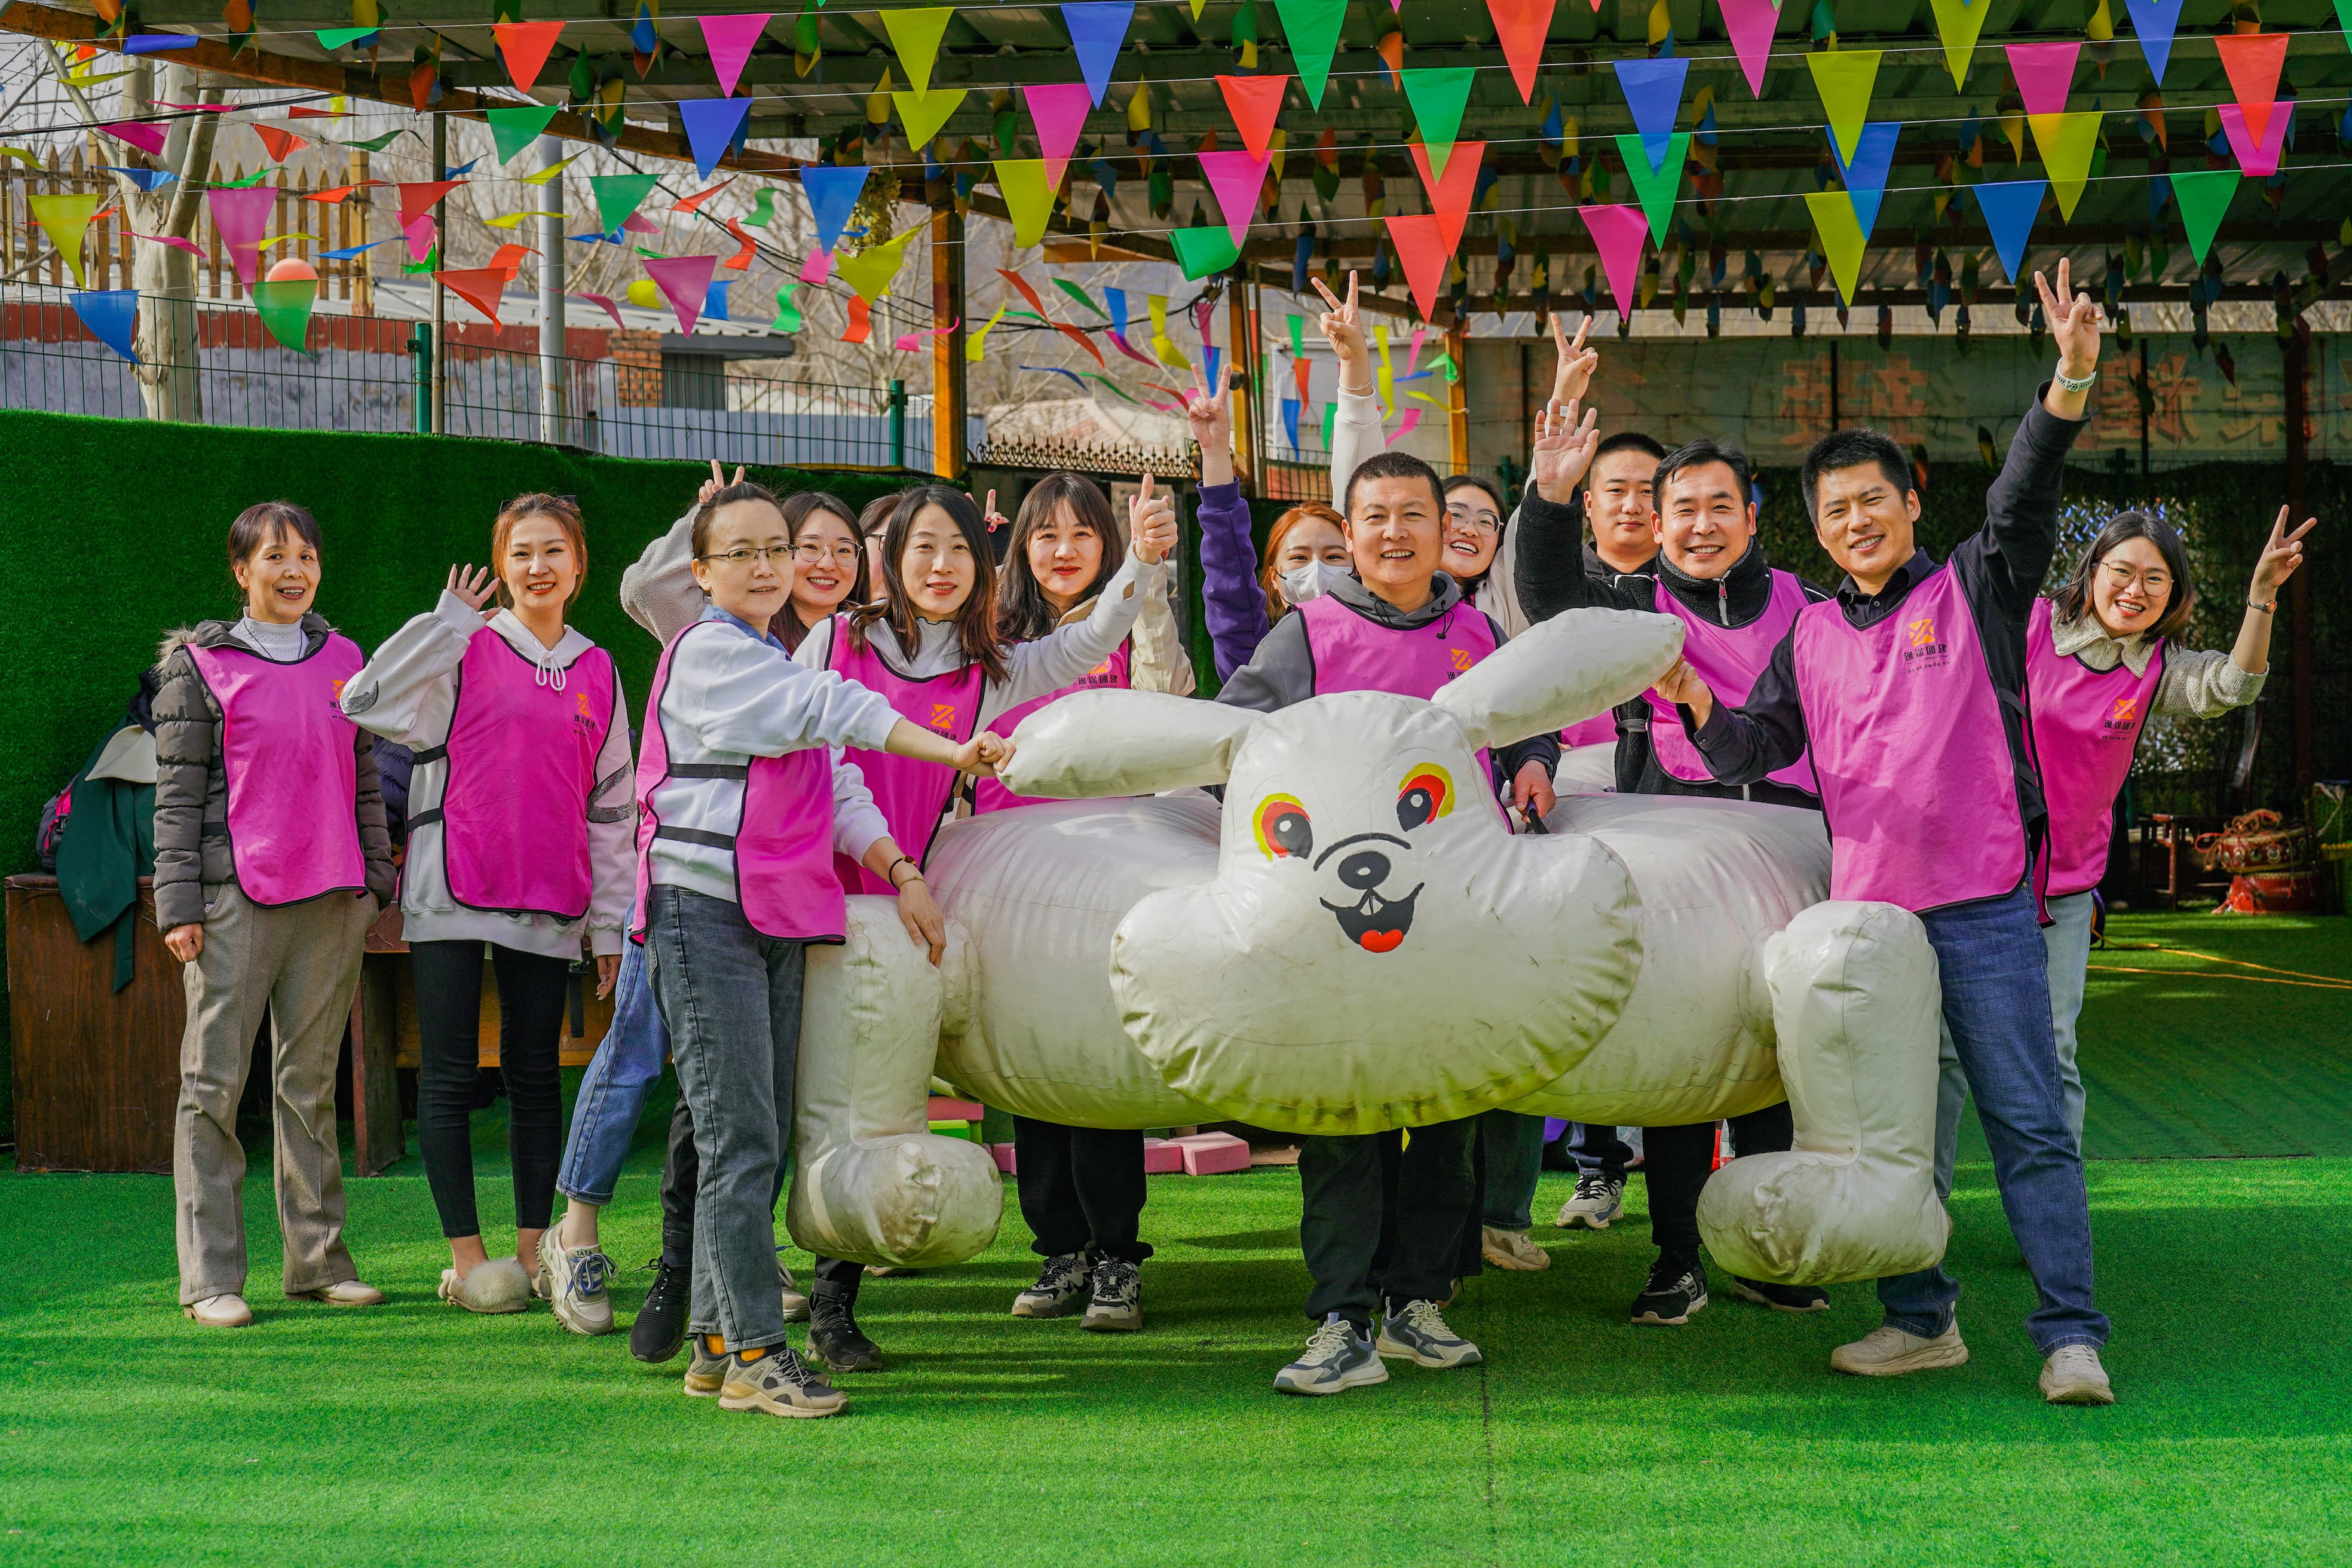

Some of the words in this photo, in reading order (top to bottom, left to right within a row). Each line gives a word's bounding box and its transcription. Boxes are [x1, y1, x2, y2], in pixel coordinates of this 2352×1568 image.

[1904, 644, 1948, 661] 逸途团建
[1078, 674, 1118, 685] 逸途团建
[920, 725, 957, 740] 途团建
